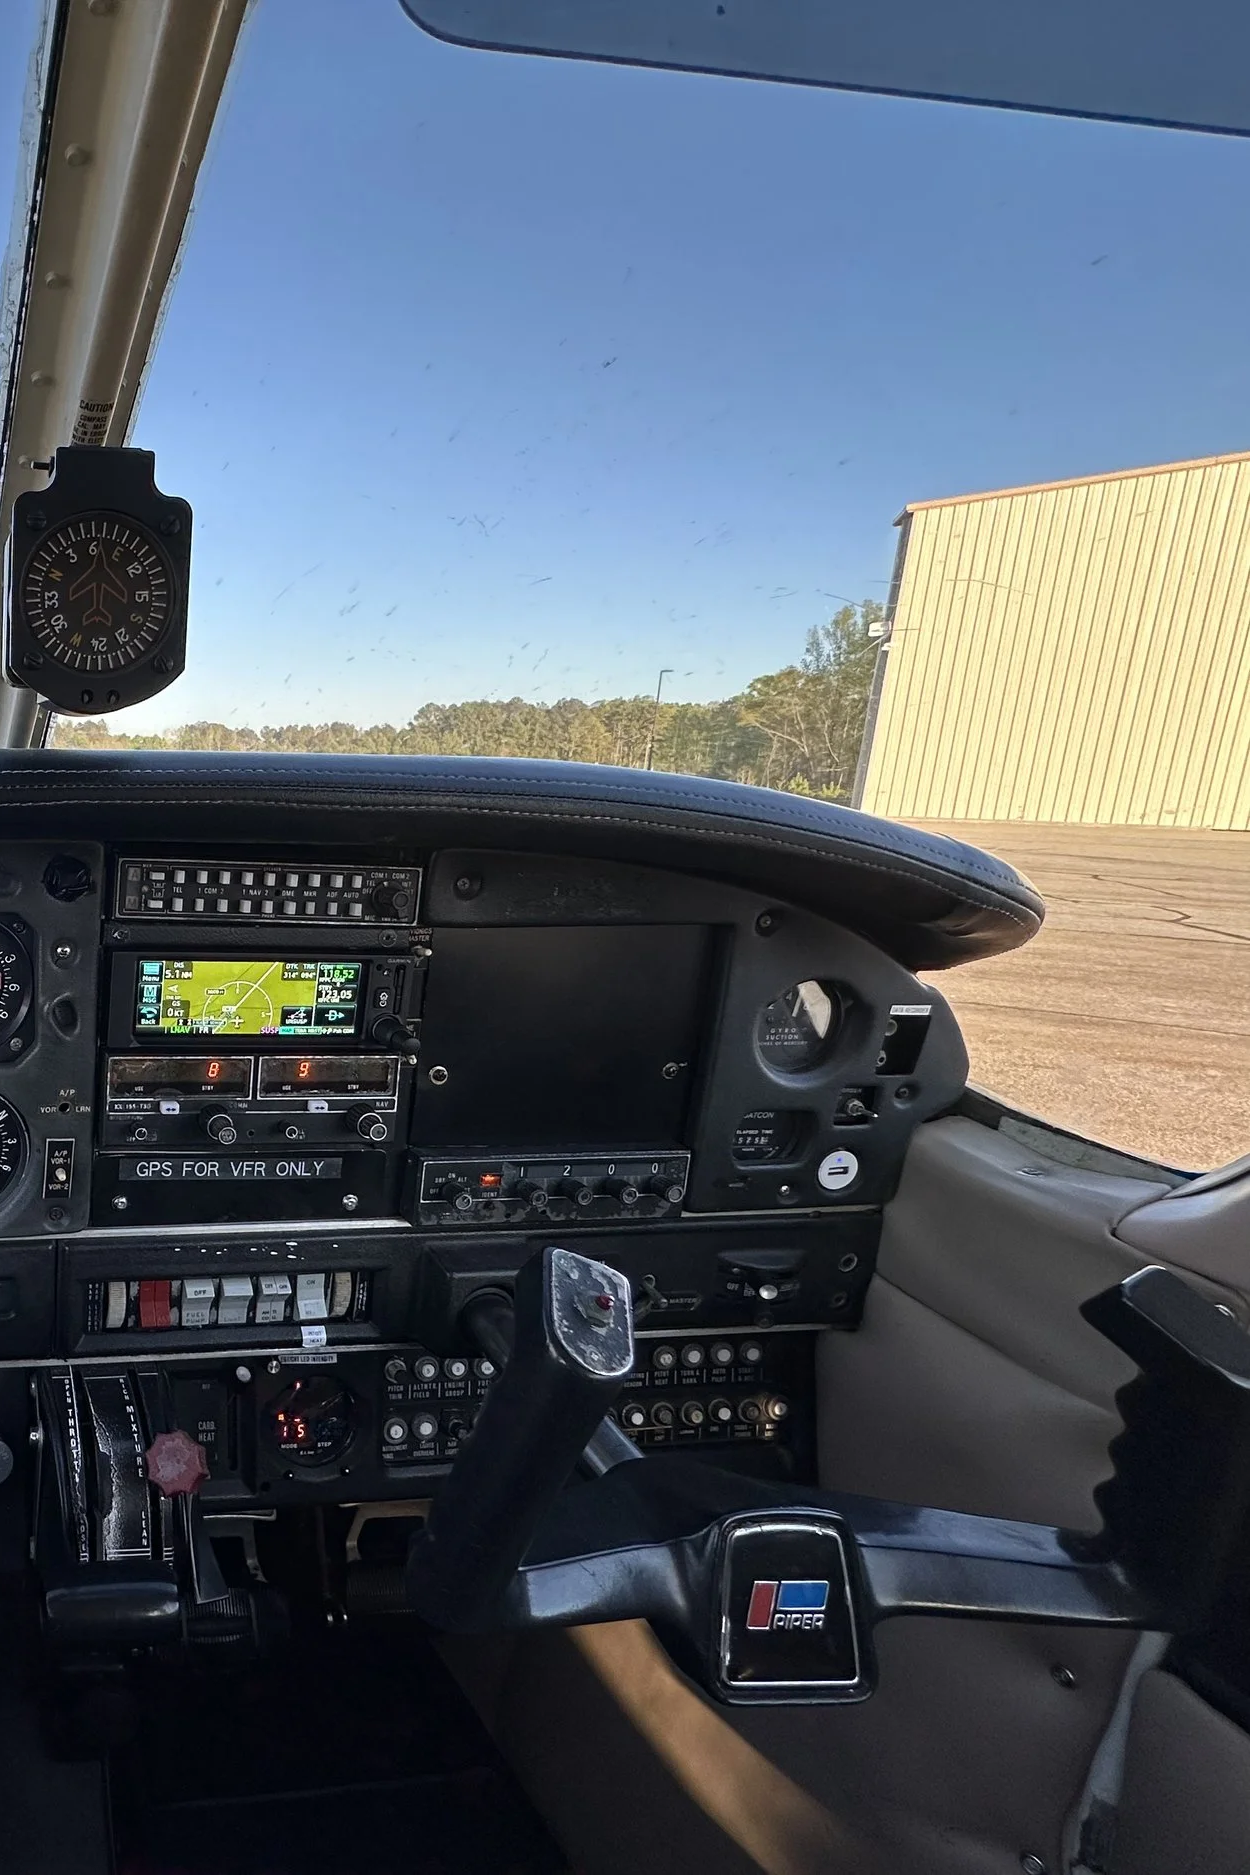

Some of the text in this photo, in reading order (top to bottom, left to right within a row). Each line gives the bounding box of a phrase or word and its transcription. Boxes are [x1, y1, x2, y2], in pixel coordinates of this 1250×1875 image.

[80, 400, 114, 412] CAUTION
[88, 541, 98, 555] 6
[112, 547, 124, 562] E
[65, 548, 78, 563] 3
[48, 568, 63, 582] N
[126, 561, 143, 578] 12
[45, 591, 58, 608] 33
[136, 591, 149, 602] 15
[51, 614, 68, 633] 30
[130, 613, 143, 625] S
[70, 632, 82, 647] W
[115, 627, 129, 644] 21
[90, 637, 107, 651] 24
[166, 970, 179, 979] 5.1
[321, 990, 352, 999] 123.05
[208, 1063, 219, 1077] 8
[299, 1062, 310, 1076] 9
[59, 1089, 75, 1097] A/P
[54, 1150, 68, 1158] A/P
[136, 1161, 325, 1177] GPS FOR VFR ONLY
[520, 1163, 659, 1177] 1 2 0 0
[126, 1406, 143, 1478] MIXTURE
[773, 1614, 825, 1630] PIPER
